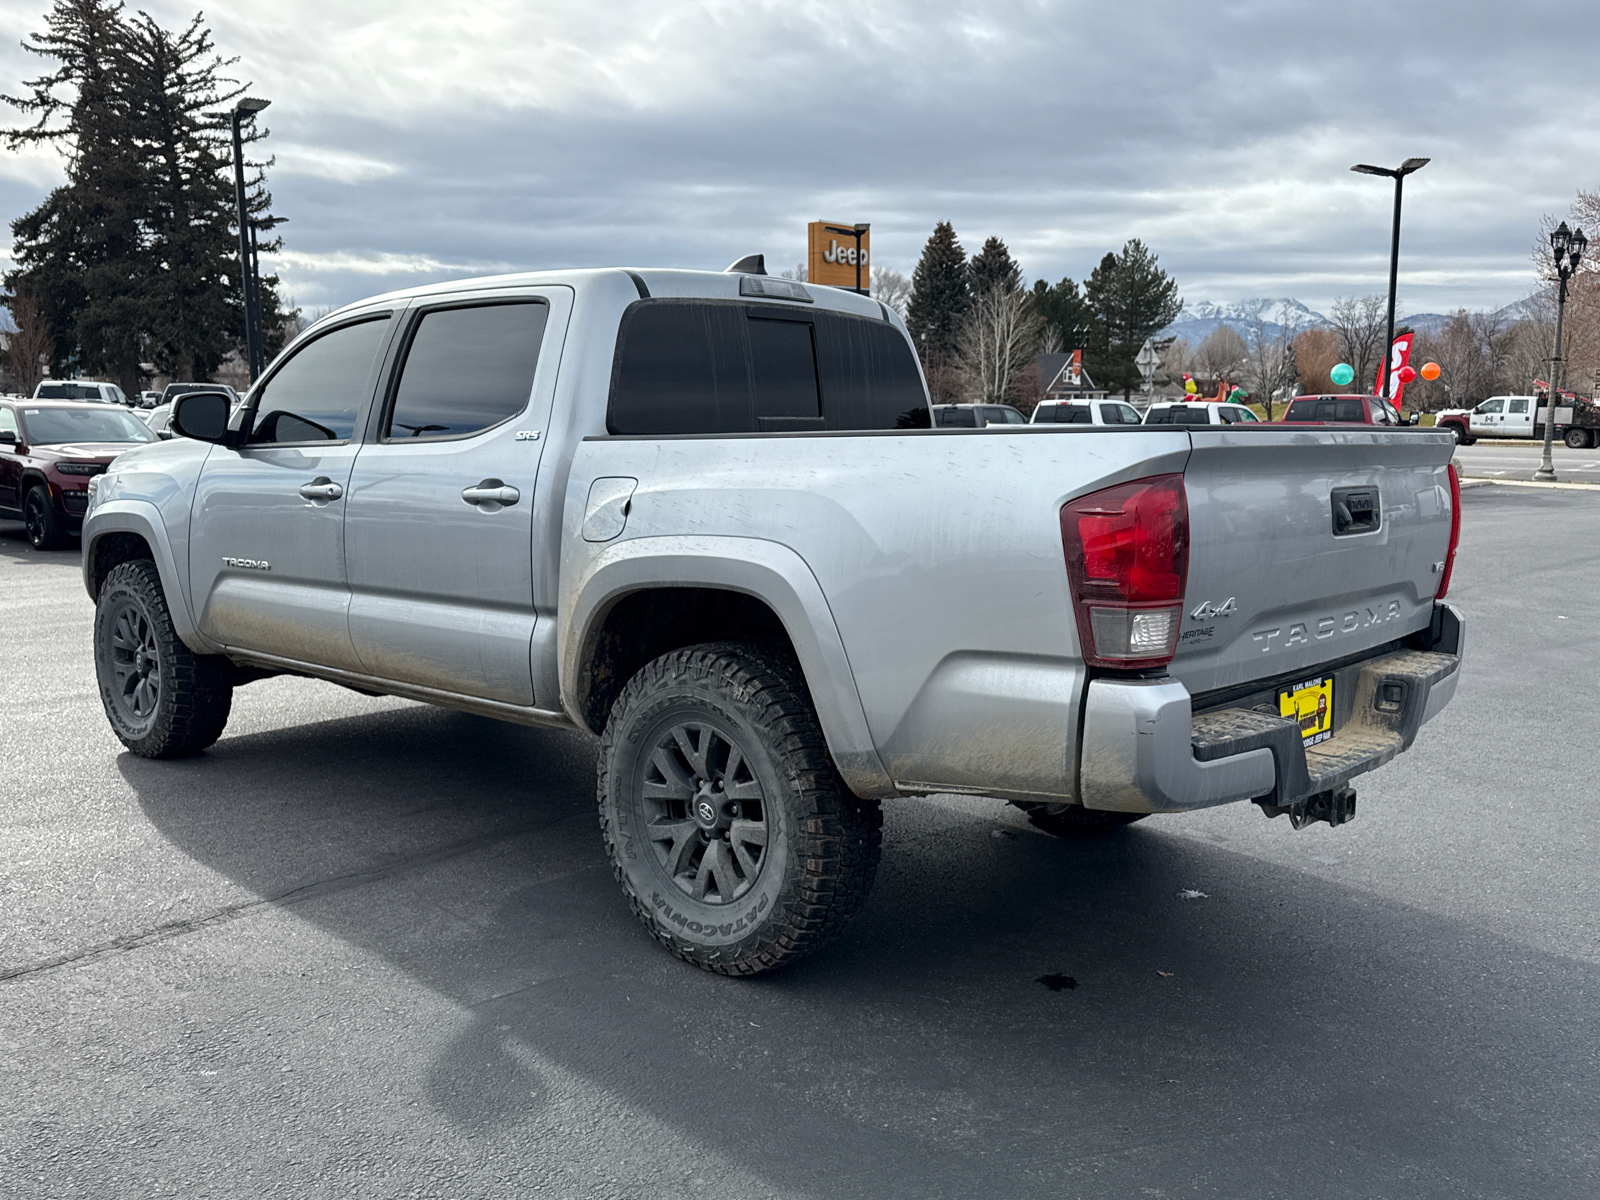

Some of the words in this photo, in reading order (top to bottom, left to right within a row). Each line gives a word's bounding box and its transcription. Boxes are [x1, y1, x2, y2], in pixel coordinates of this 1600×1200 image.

[823, 240, 868, 267] Jeep
[515, 430, 541, 441] SR5
[222, 557, 271, 570] TACOMA
[1178, 626, 1215, 642] HERITAGE
[1252, 600, 1400, 652] TACOMA
[1292, 682, 1305, 692] KARL
[651, 892, 769, 937] PATAGONIA
